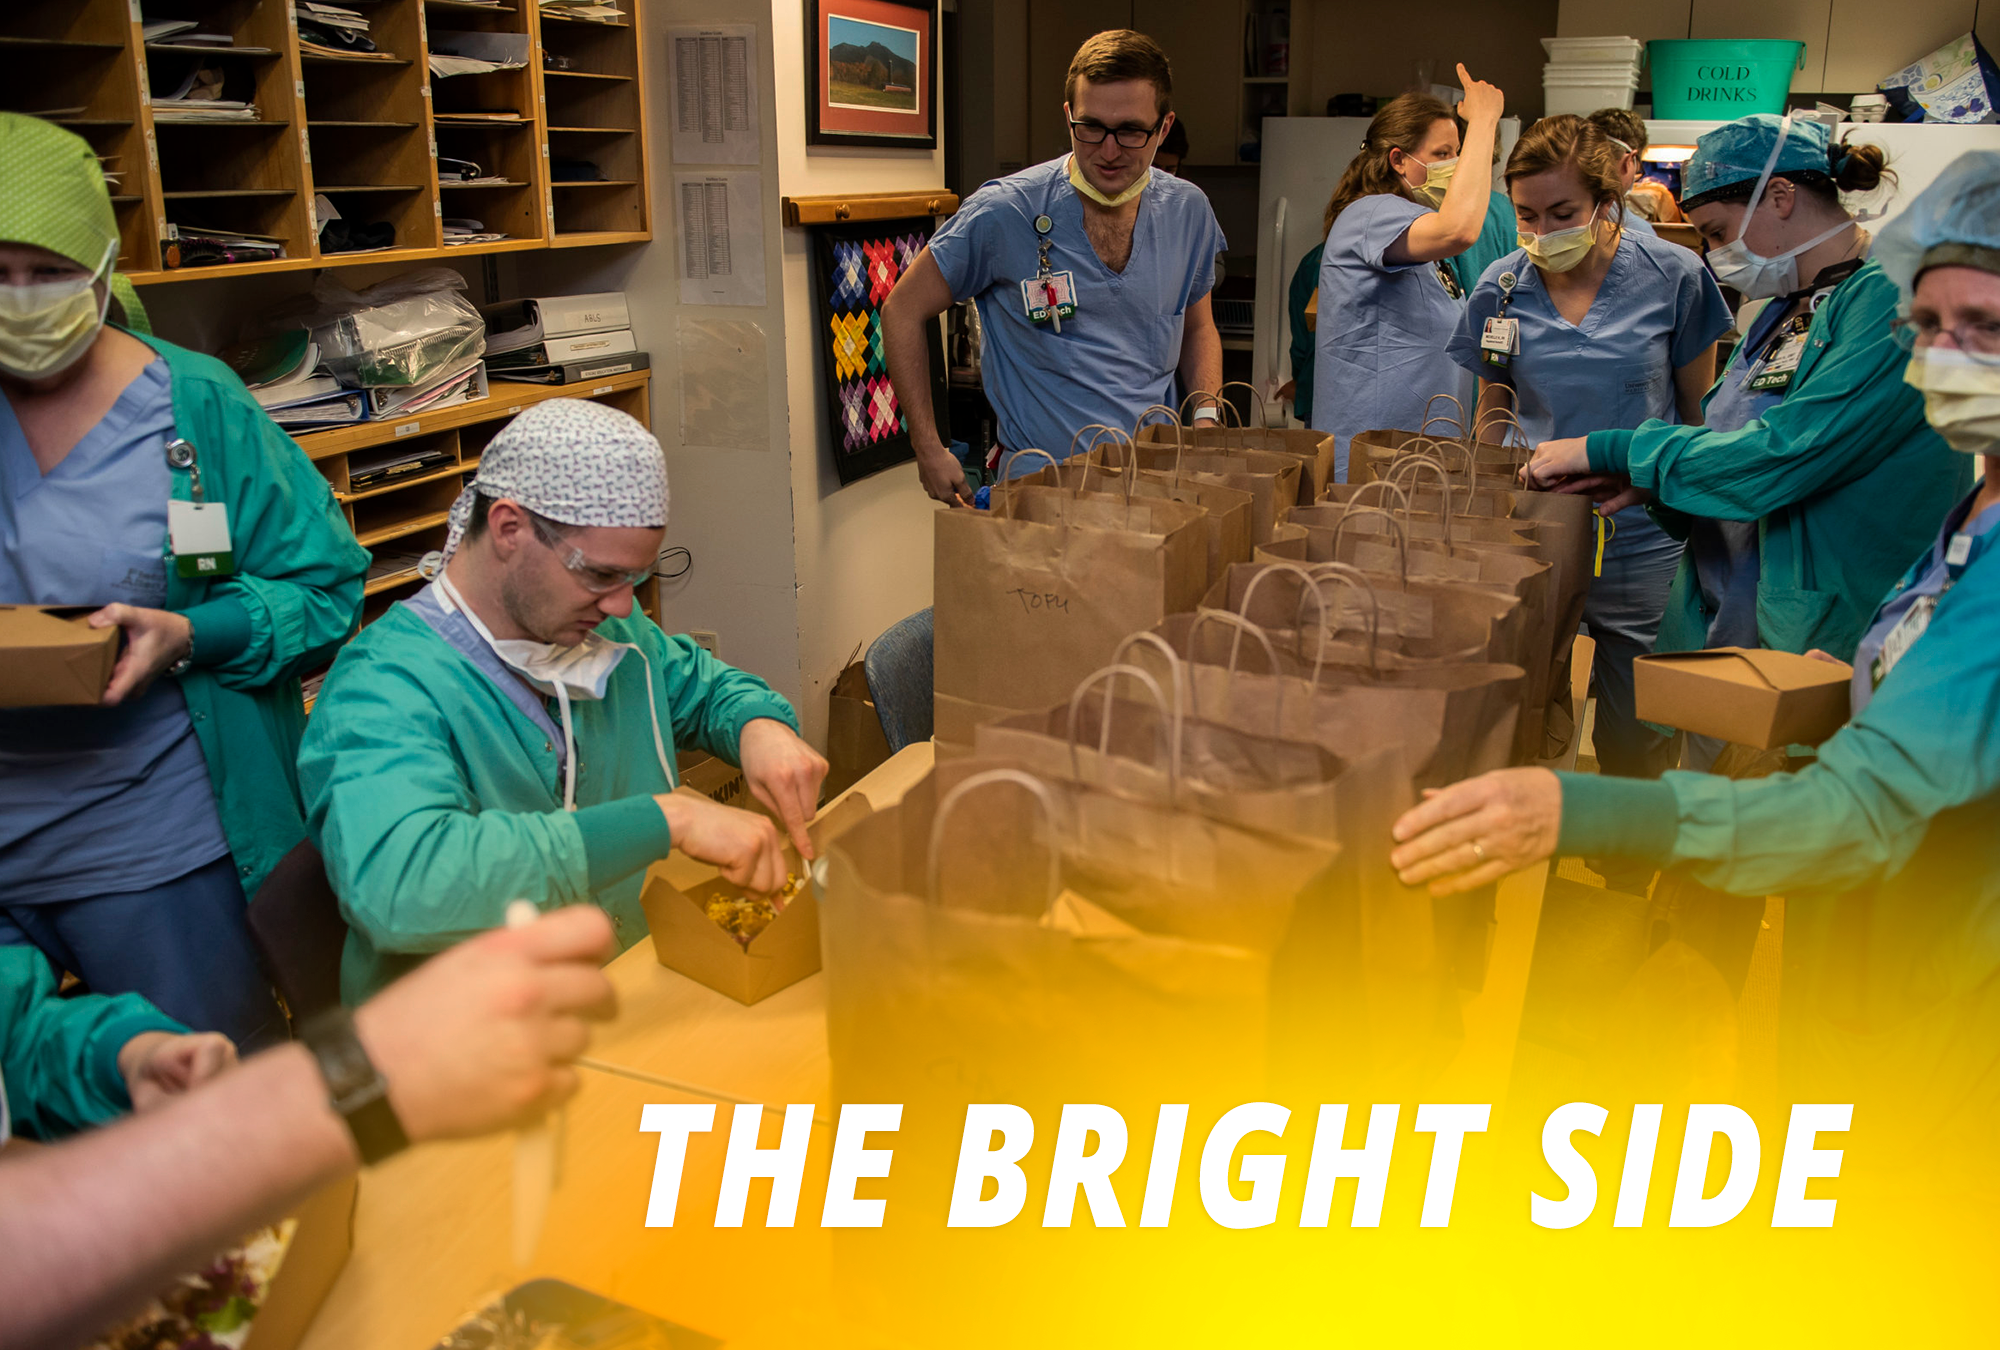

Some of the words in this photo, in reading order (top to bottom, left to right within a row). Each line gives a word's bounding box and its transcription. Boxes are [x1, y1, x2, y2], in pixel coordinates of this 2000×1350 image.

[1697, 65, 1750, 81] COLD
[1686, 87, 1757, 102] DRINKS
[1033, 310, 1046, 319] ED
[1752, 378, 1766, 387] ED
[1766, 374, 1788, 385] Tech
[197, 557, 217, 571] RN
[708, 774, 743, 804] KIN'
